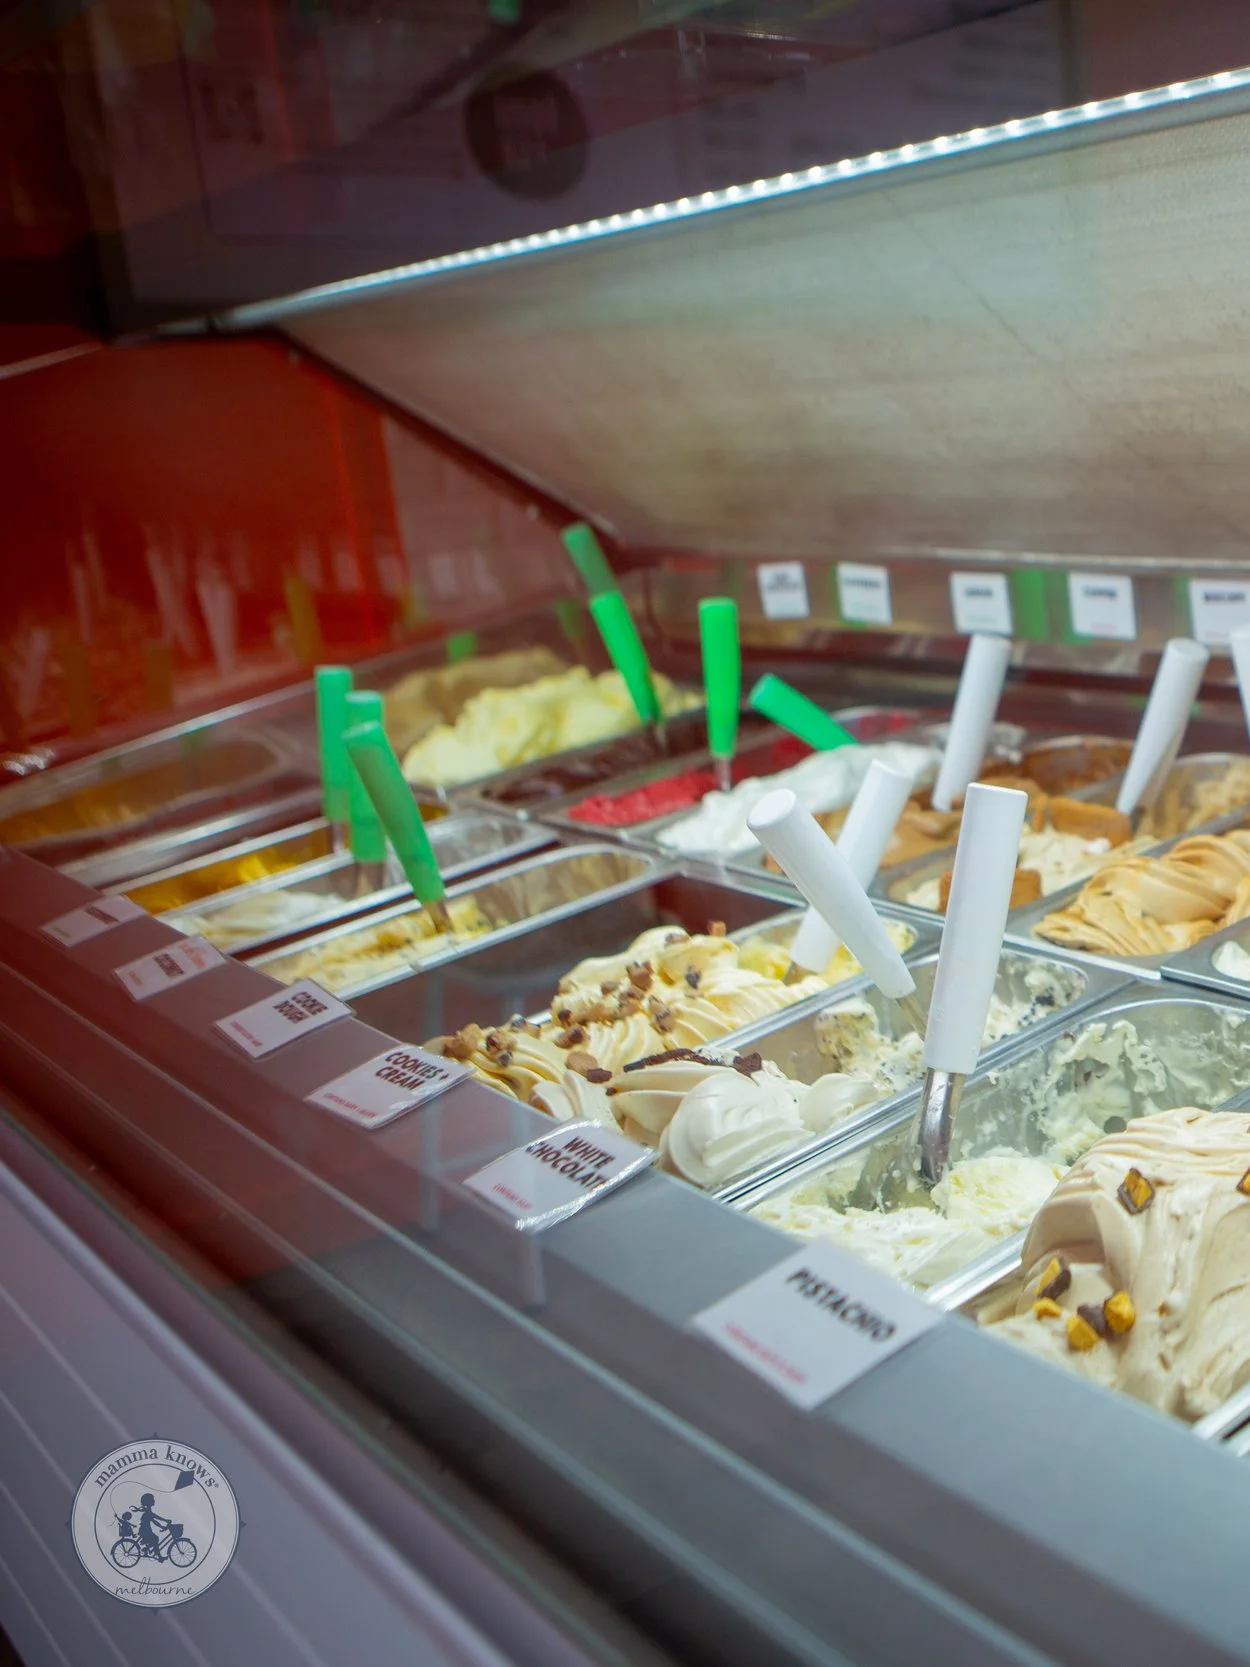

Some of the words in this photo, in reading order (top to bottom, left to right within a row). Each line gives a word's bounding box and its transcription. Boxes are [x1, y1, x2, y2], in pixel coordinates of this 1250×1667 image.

[373, 1066, 426, 1091] CREAM
[384, 1052, 443, 1080] COOKIES
[563, 1136, 616, 1170] WHITE
[785, 1267, 898, 1344] PISTACHIO
